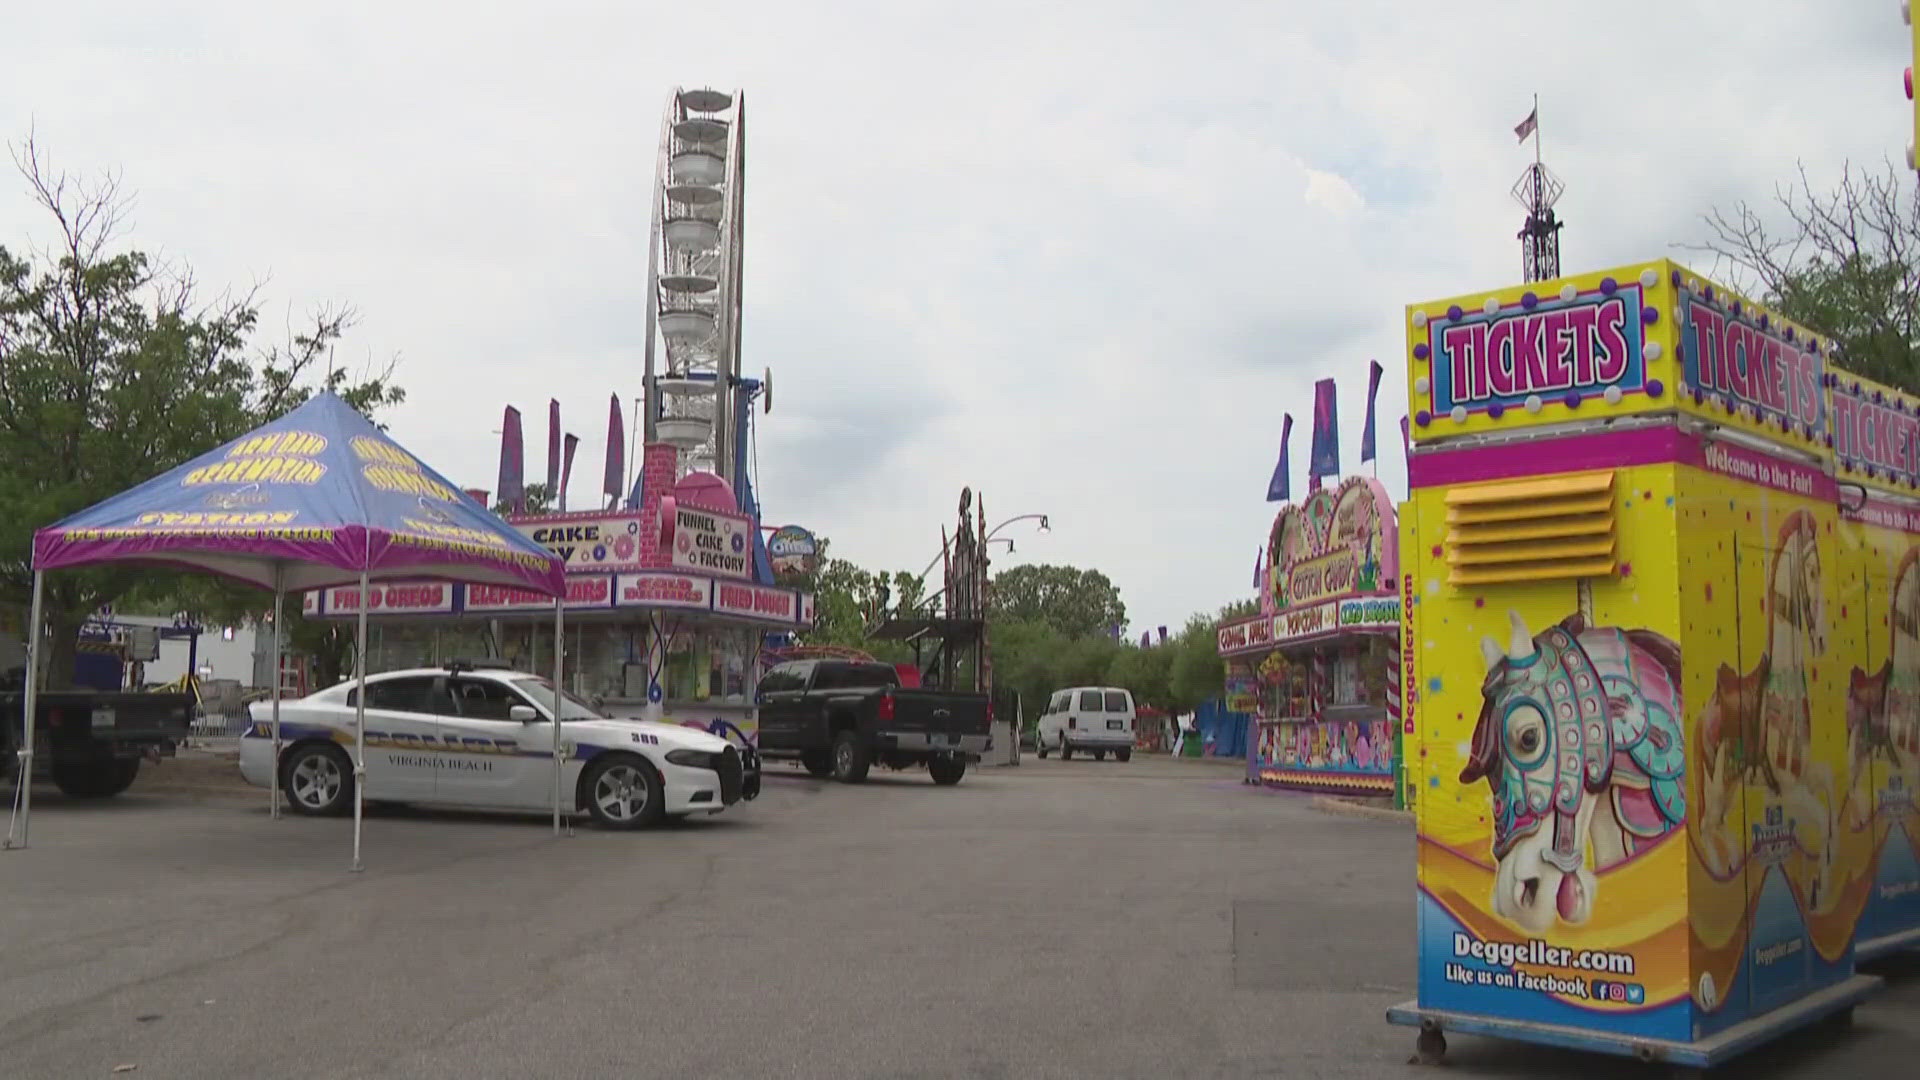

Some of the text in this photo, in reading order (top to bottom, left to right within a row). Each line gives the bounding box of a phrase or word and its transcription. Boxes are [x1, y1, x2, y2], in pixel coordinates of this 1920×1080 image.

[1443, 299, 1628, 404] TICKETS
[1688, 300, 1819, 427] TICKETS
[1832, 391, 1920, 477] TICKET
[182, 457, 328, 486] REDEMPTION
[1705, 445, 1813, 495] Welcome to the Fair!
[135, 510, 298, 526] STATION
[676, 510, 717, 533] FUNNEL
[262, 527, 334, 543] STATION
[533, 526, 599, 543] CAKE
[695, 533, 723, 552] CAKE
[699, 553, 745, 574] FACTORY
[1293, 556, 1354, 601] COTTON CANDY
[334, 588, 382, 610] FRID
[719, 585, 753, 610] FRIED
[753, 588, 791, 616] DOUGH
[1286, 607, 1328, 637] POPCORN
[1404, 574, 1416, 735] Deggeller.com
[388, 755, 492, 773] VIRGINIA BEACH
[1453, 932, 1635, 975] Deggeller.com
[1445, 963, 1590, 999] Like us on Facebook
